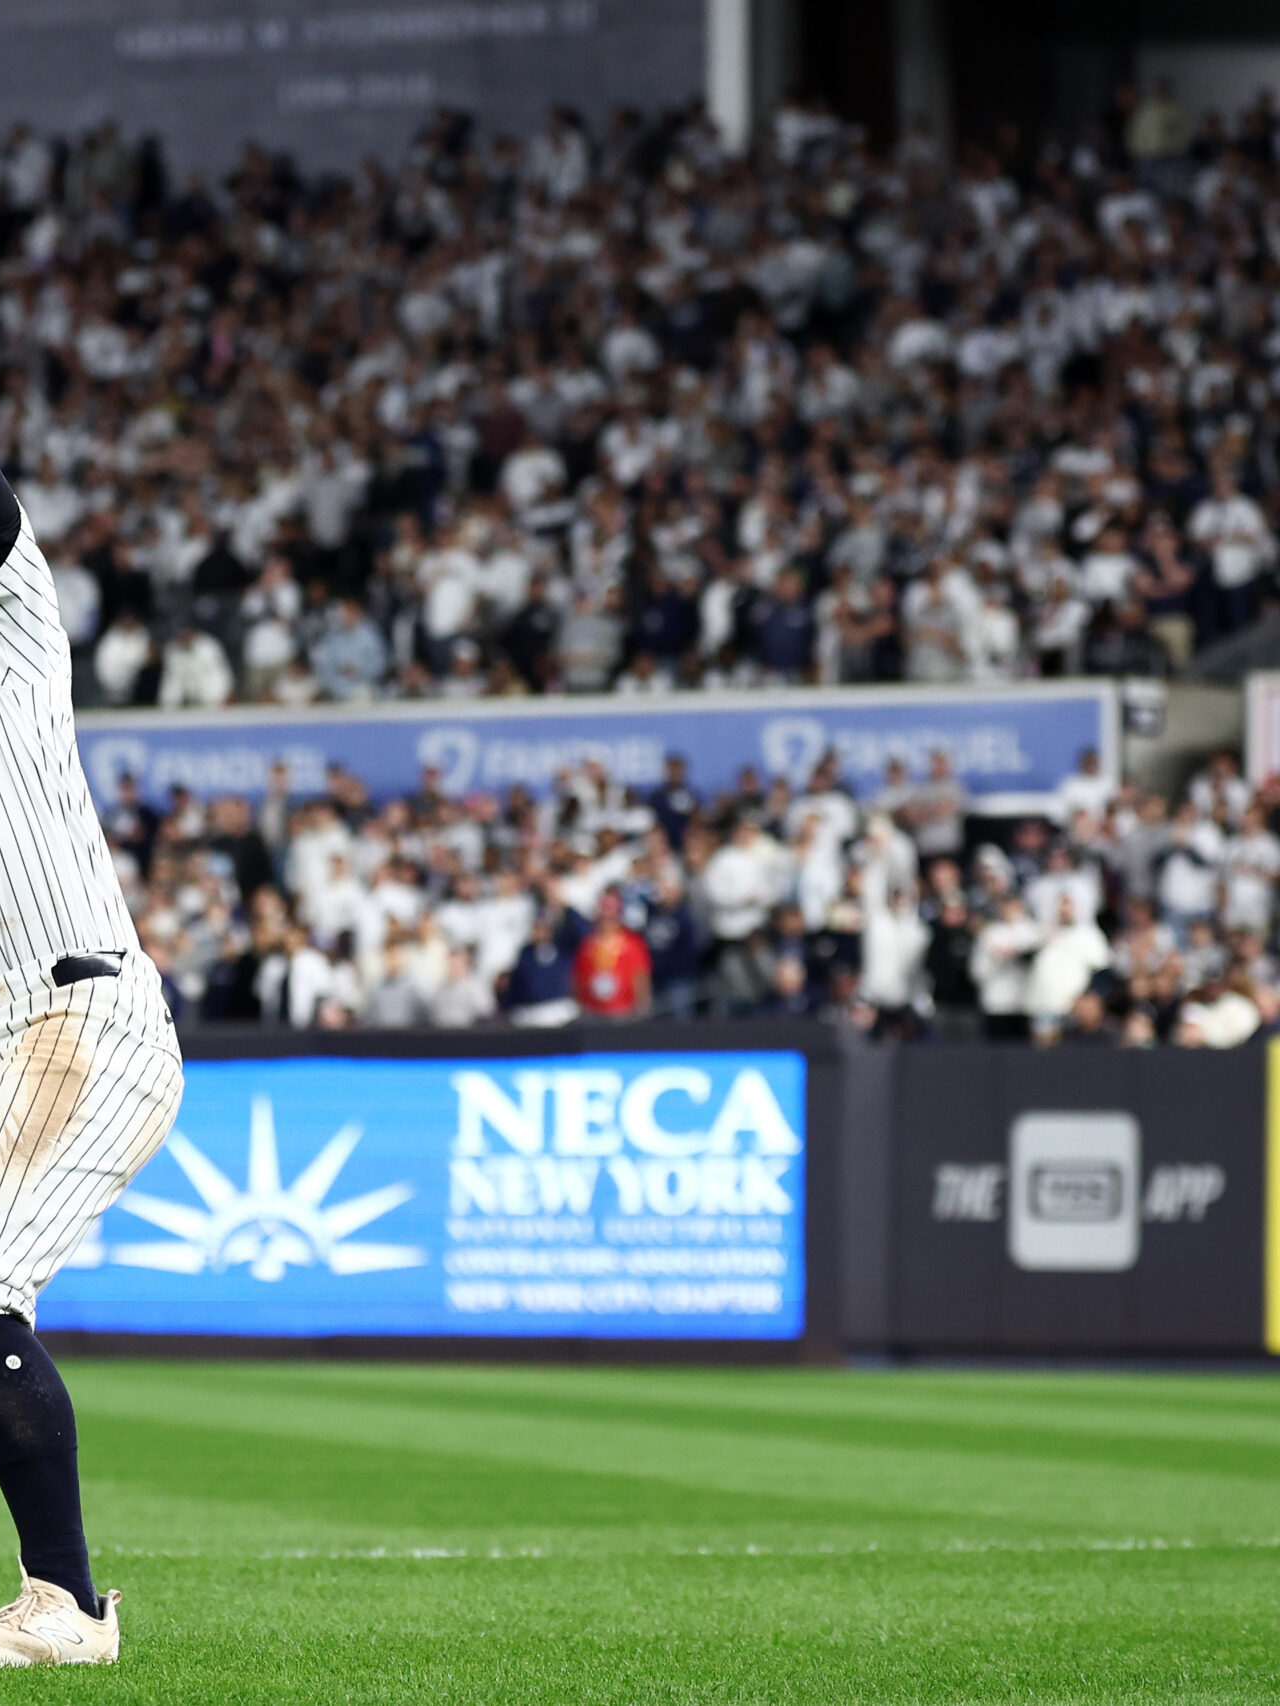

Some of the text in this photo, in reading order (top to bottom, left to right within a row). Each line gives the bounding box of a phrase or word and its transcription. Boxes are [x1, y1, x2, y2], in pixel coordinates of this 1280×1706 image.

[451, 1067, 802, 1156] NECA
[449, 1155, 793, 1216] NEW YORK
[932, 1163, 1004, 1221] THE
[1144, 1163, 1225, 1222] APP
